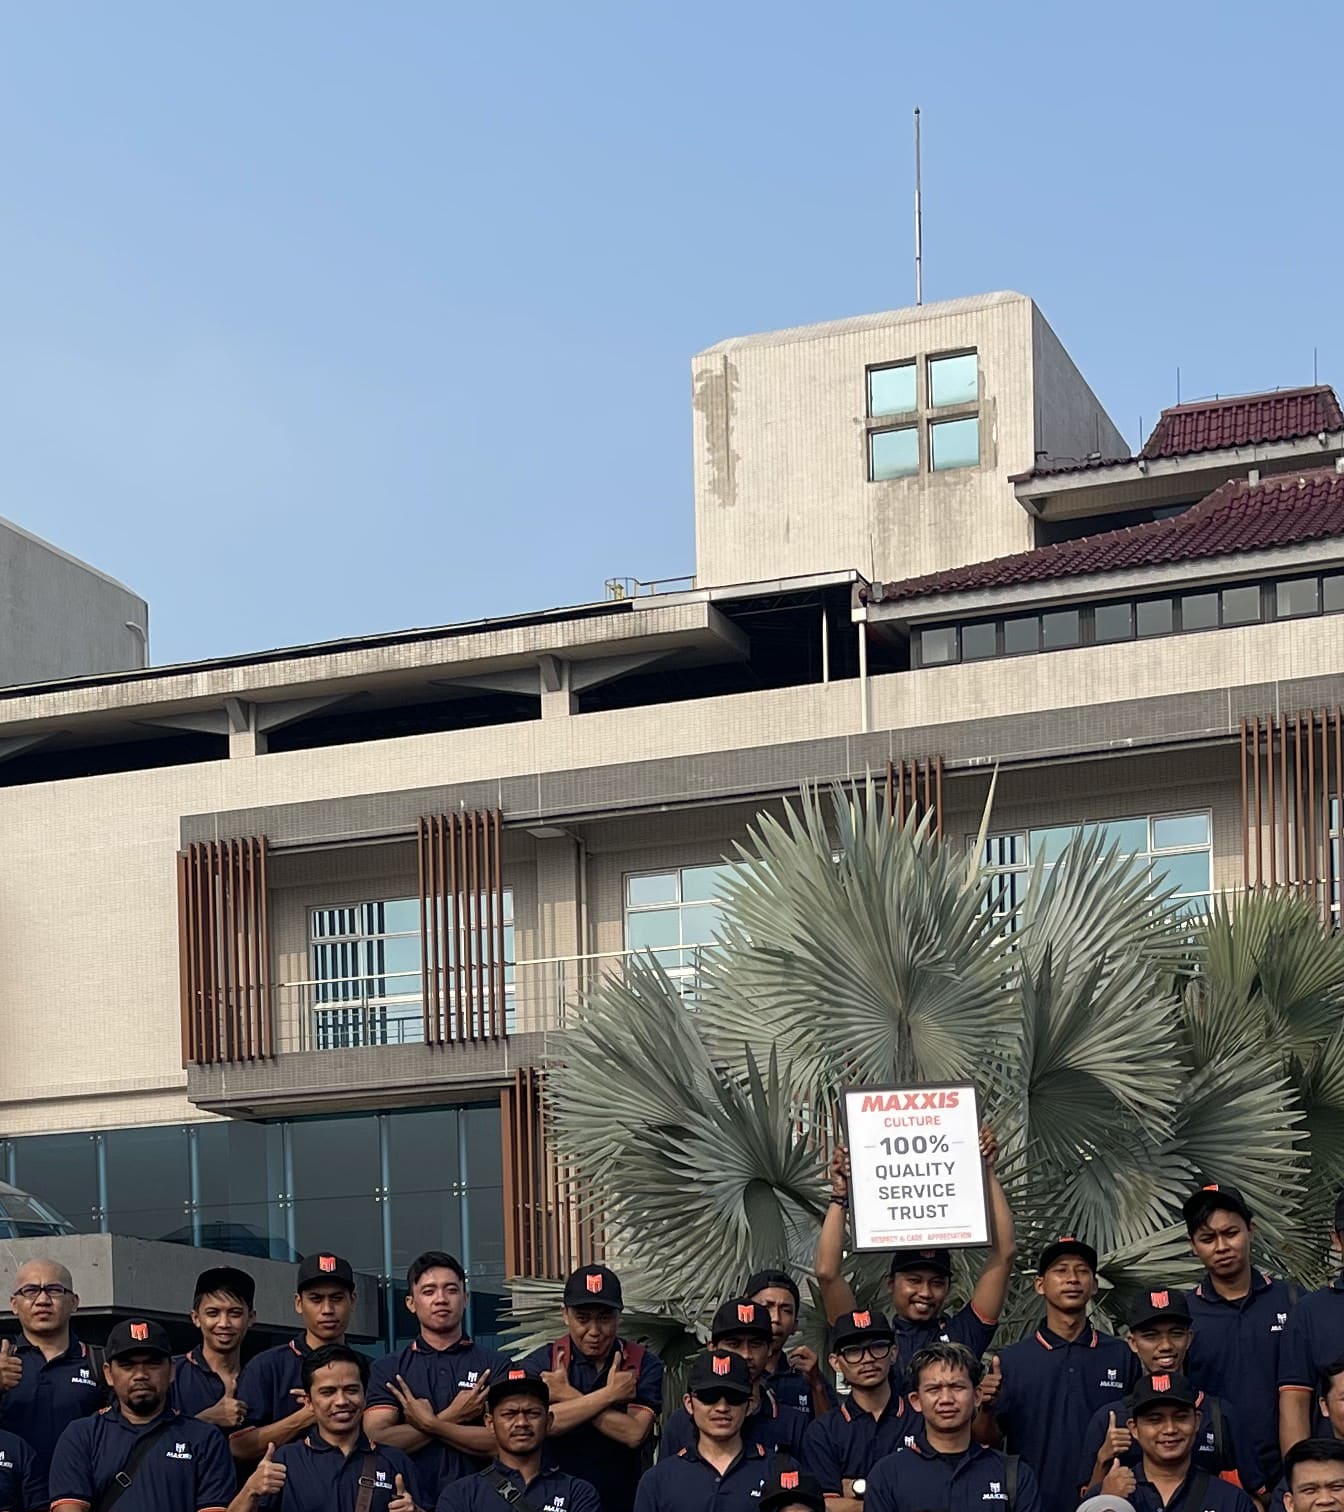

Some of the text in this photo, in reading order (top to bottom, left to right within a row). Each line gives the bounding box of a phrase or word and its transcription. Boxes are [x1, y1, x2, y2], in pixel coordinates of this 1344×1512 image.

[861, 1092, 959, 1113] MAXXIS
[884, 1115, 941, 1128] CULTURE
[880, 1134, 949, 1156] 100%
[875, 1161, 955, 1180] QUALITY
[879, 1183, 956, 1200] SERVICE
[887, 1204, 948, 1221] TRUST
